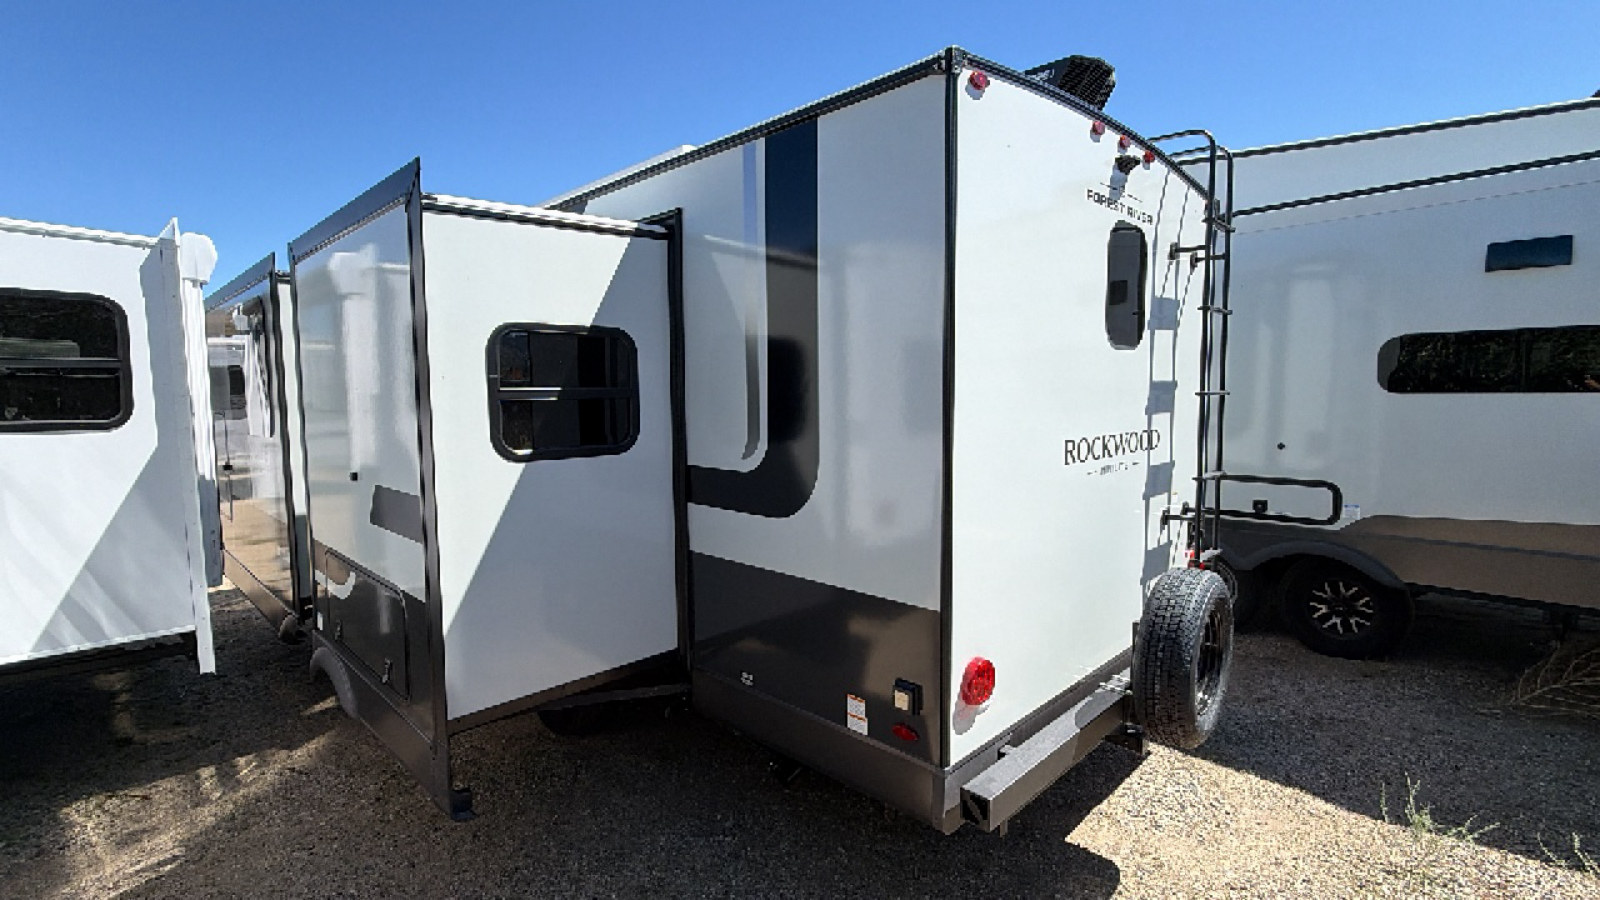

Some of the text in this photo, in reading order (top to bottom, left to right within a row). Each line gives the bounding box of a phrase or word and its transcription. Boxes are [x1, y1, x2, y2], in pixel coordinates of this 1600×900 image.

[1087, 189, 1125, 213] FOREST
[1127, 206, 1153, 225] RIVER
[1064, 430, 1160, 465] ROCKWOOD
